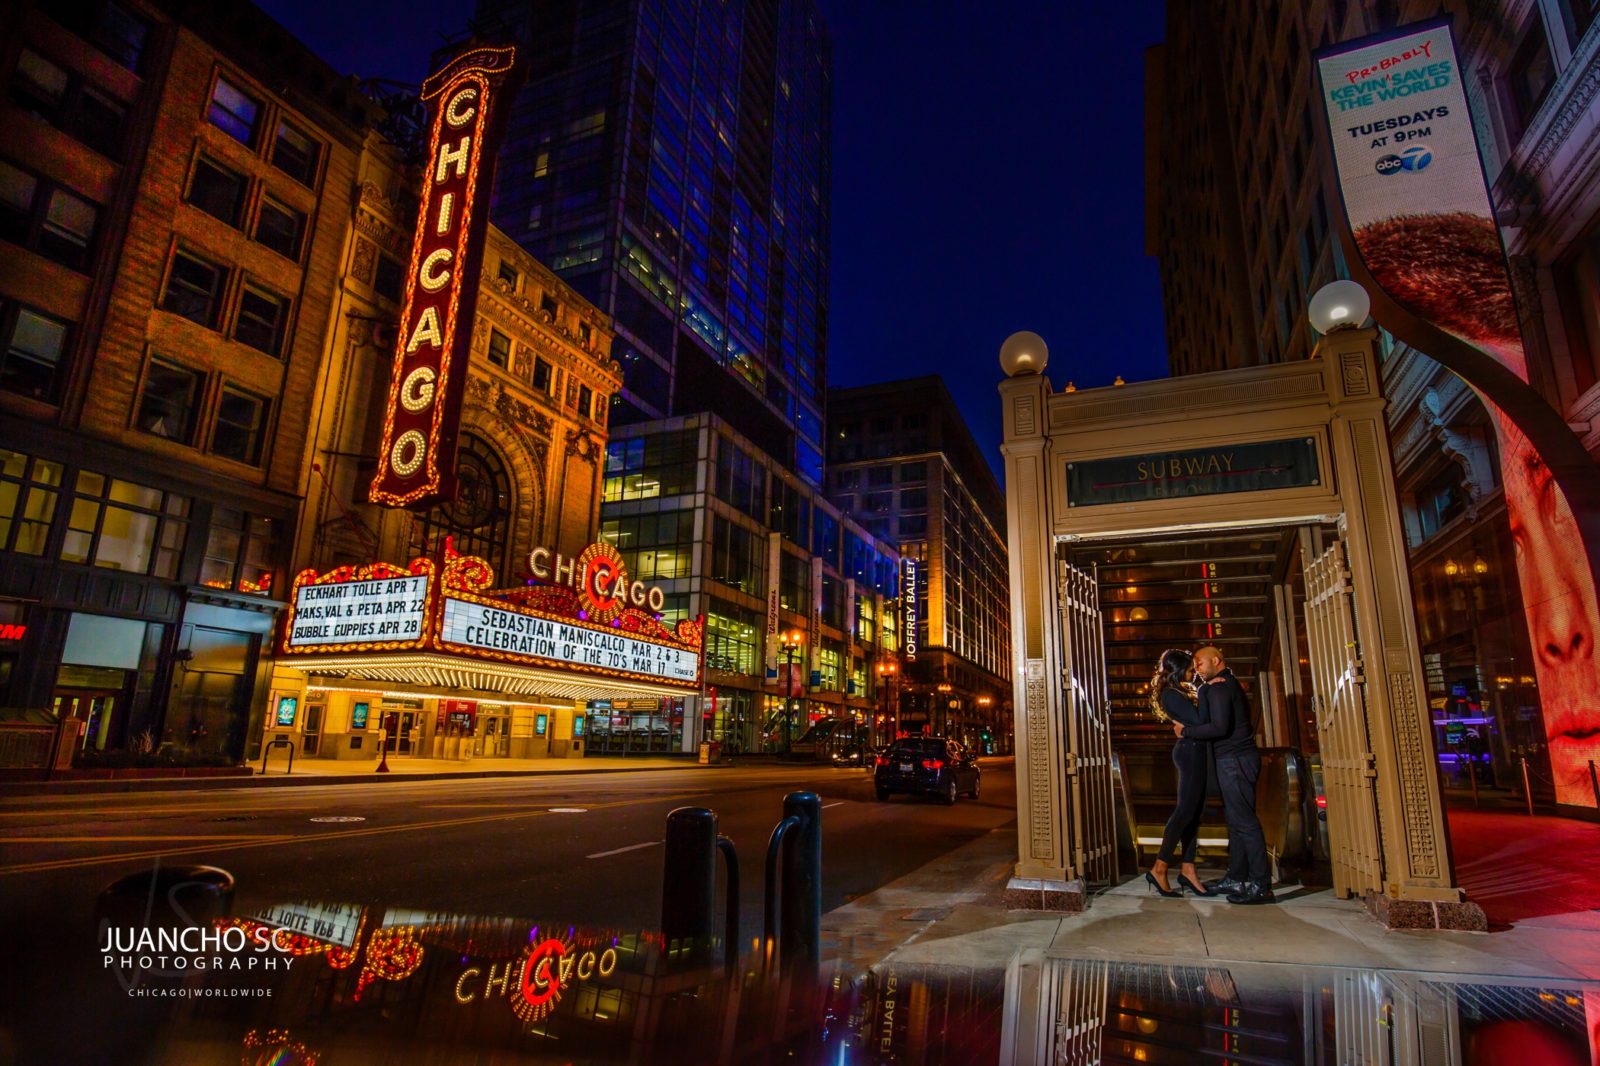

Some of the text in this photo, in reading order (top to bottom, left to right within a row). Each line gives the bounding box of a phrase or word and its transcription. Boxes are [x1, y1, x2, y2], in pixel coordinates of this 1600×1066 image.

[1330, 61, 1451, 101] KEVIN SAVES
[1337, 75, 1450, 111] THE WORLD
[1347, 106, 1449, 138] TUESDAYS
[1370, 127, 1432, 149] AT 9PM
[1376, 158, 1401, 171] abc
[391, 88, 477, 476] CHICAGO
[1137, 453, 1234, 481] SUBWAY
[305, 579, 419, 600] ECKHART TOLLE APR 7
[530, 547, 664, 611] CHICAGO
[346, 604, 353, 616] &
[357, 601, 383, 615] PETA
[386, 600, 406, 613] APR
[411, 599, 425, 612] 22
[906, 560, 916, 660] JOFFREY BALLET
[294, 620, 418, 639] BUBBLE GUPPIES APR 28
[481, 609, 554, 639] SEBASTIAN
[559, 624, 625, 653] MANISCALCO
[631, 641, 652, 659] MAR
[656, 647, 662, 660] 2
[675, 651, 680, 663] 3
[466, 625, 666, 675] CELEBRATION OF THE 70'S MAR 17
